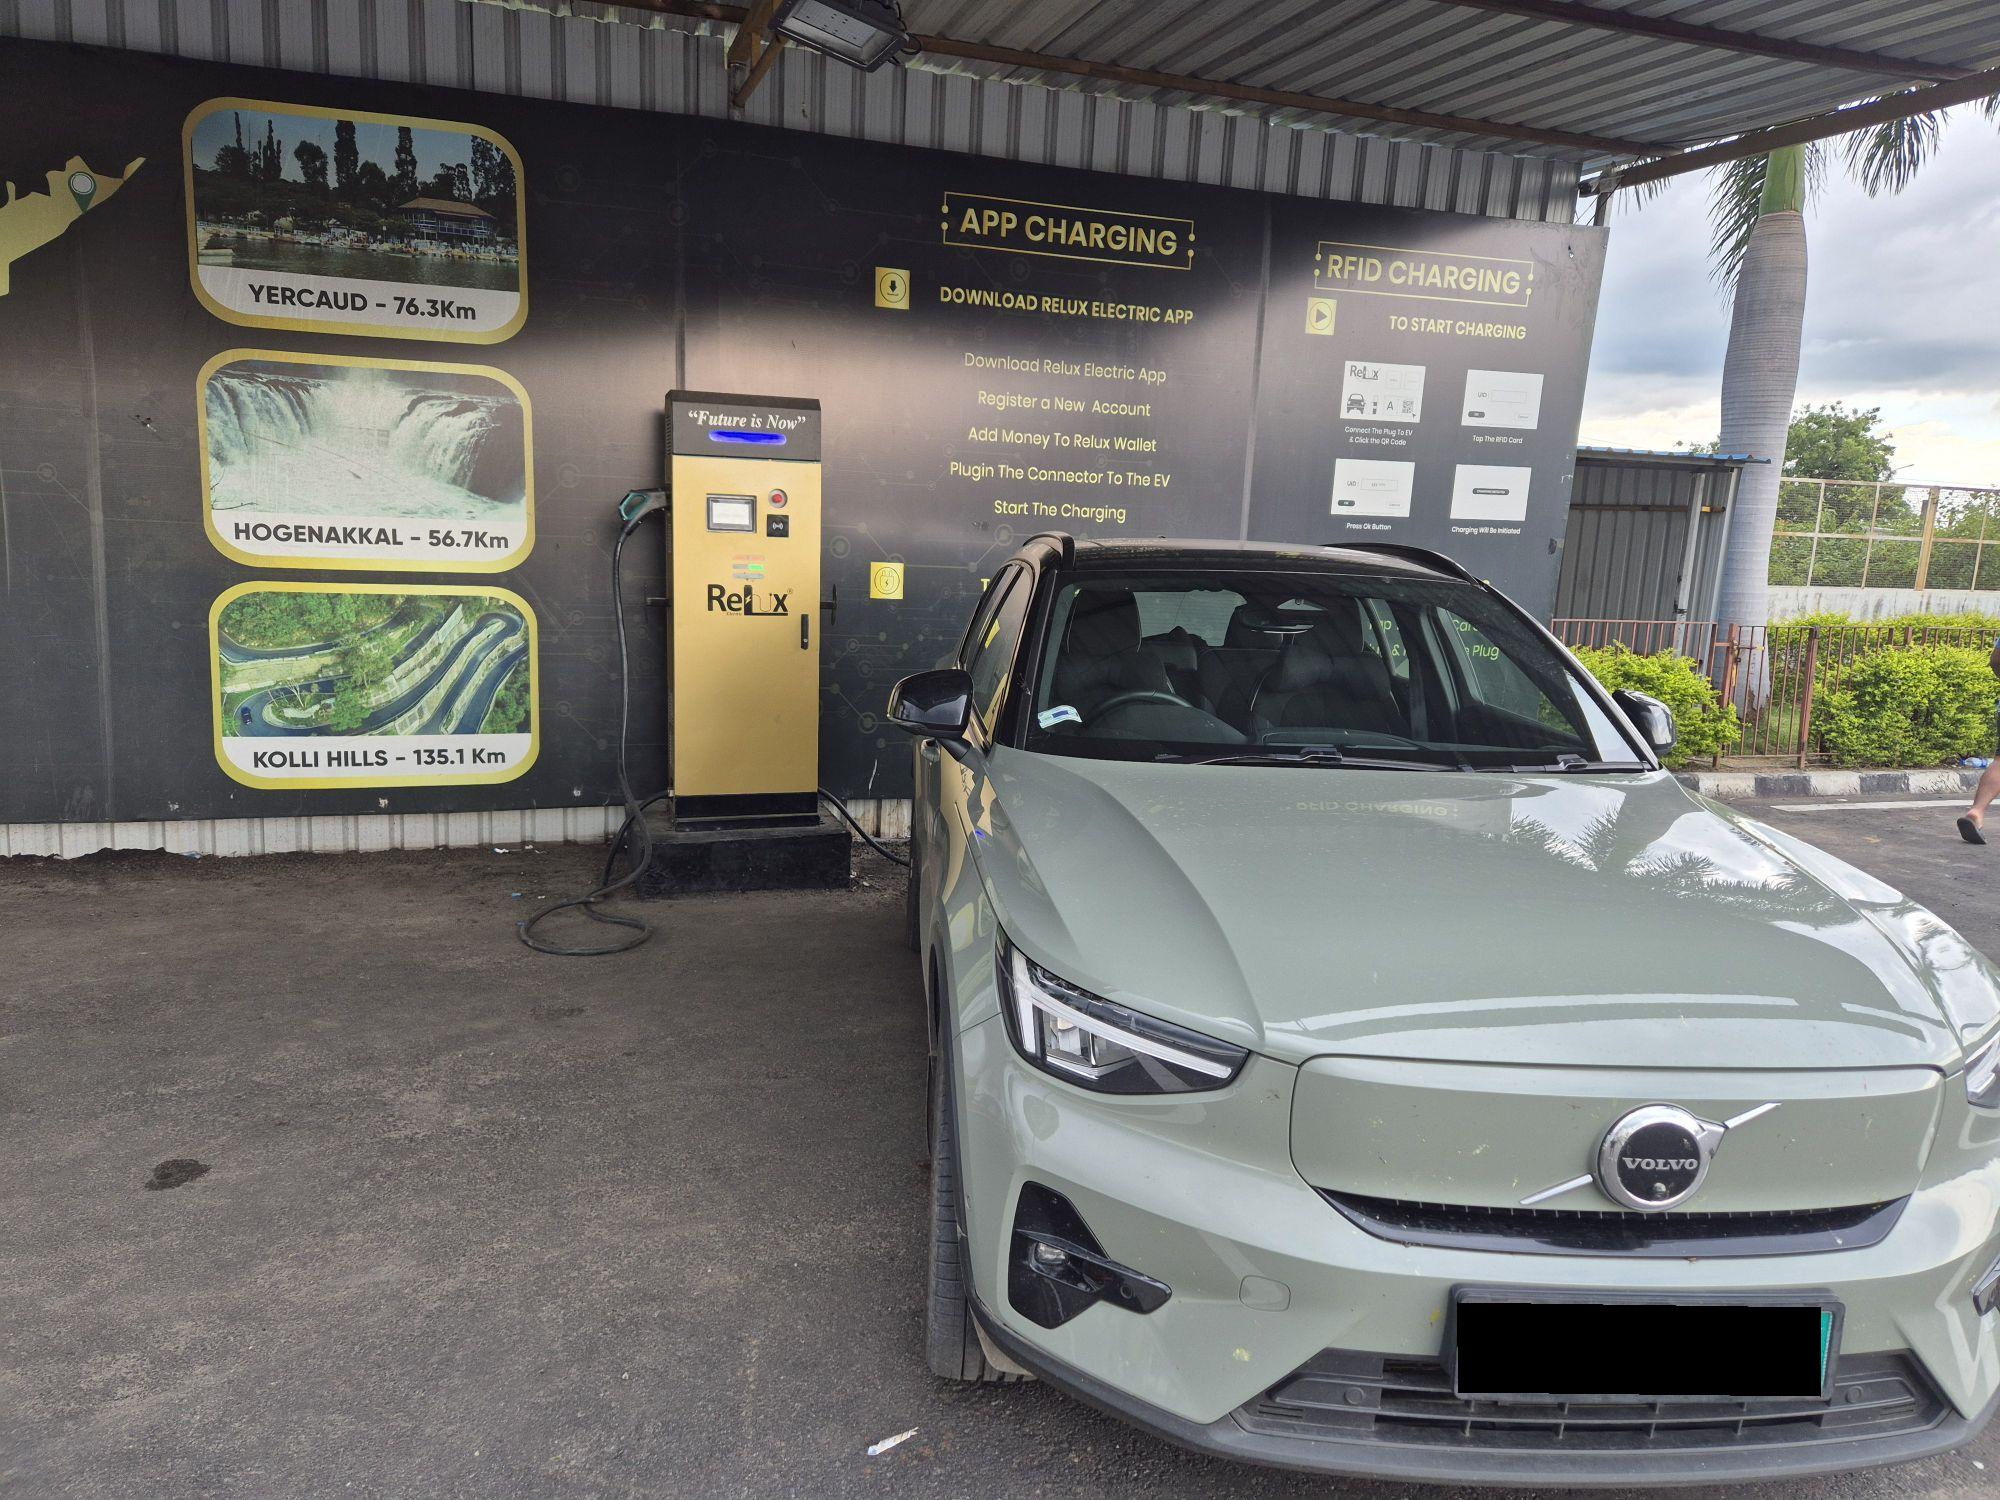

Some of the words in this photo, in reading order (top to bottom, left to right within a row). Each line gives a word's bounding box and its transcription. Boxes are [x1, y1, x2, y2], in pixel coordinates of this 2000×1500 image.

[960, 207, 1018, 238] APP
[1025, 214, 1178, 256] CHARGING
[1327, 254, 1382, 282] RFID
[1388, 260, 1521, 295] CHARGING
[248, 283, 368, 312] YERCAUD
[393, 296, 477, 320] 76.3Km
[940, 286, 1038, 312] DOWNLOAD
[1041, 296, 1088, 316] RELUX
[1092, 301, 1161, 322] ELECTRIC
[1164, 308, 1194, 325] APP
[1389, 315, 1408, 331] TO
[1410, 317, 1453, 335] START
[1456, 320, 1528, 340] CHARGING
[964, 352, 1040, 373] Download
[1043, 359, 1081, 375] Relux
[1084, 362, 1135, 379] Electric
[1138, 367, 1167, 386] App
[978, 391, 1037, 411] Register
[1041, 399, 1051, 411] a
[1054, 397, 1085, 412] New
[1092, 400, 1151, 417] Account
[750, 413, 763, 428] is
[1344, 426, 1371, 434] Connect
[1372, 427, 1383, 435] The
[1383, 428, 1396, 437] Plug
[968, 426, 998, 442] Add
[1002, 429, 1050, 450] Money
[1053, 432, 1071, 446] To
[1073, 434, 1110, 450] Relux
[1114, 436, 1157, 452] Wallet
[1354, 436, 1370, 444] Click
[1381, 438, 1390, 446] QR
[1390, 438, 1407, 446] Code
[1472, 434, 1484, 444] Tap
[1484, 435, 1495, 443] The
[1495, 436, 1508, 444] RFID
[1508, 436, 1523, 444] Card
[950, 462, 995, 482] Plugin
[998, 464, 1024, 480] The
[1027, 466, 1103, 485] Connector
[1106, 470, 1123, 485] To
[1126, 472, 1151, 487] The
[1154, 474, 1171, 488] EV
[994, 500, 1028, 516] Start
[1032, 502, 1058, 517] The
[1061, 503, 1127, 523] Charging
[234, 522, 403, 546] HOGENAKKAL
[428, 529, 509, 549] 56.7Km
[1346, 522, 1362, 530] Press
[1372, 523, 1392, 531] Button
[1451, 526, 1478, 535] Charging
[1497, 527, 1521, 535] Initiated
[1472, 644, 1500, 661] Plug
[253, 751, 319, 768] KOLLI
[327, 750, 388, 768] HILLS
[413, 748, 464, 765] 135.1
[472, 748, 506, 764] Km
[1622, 1157, 1698, 1170] VOLVO
